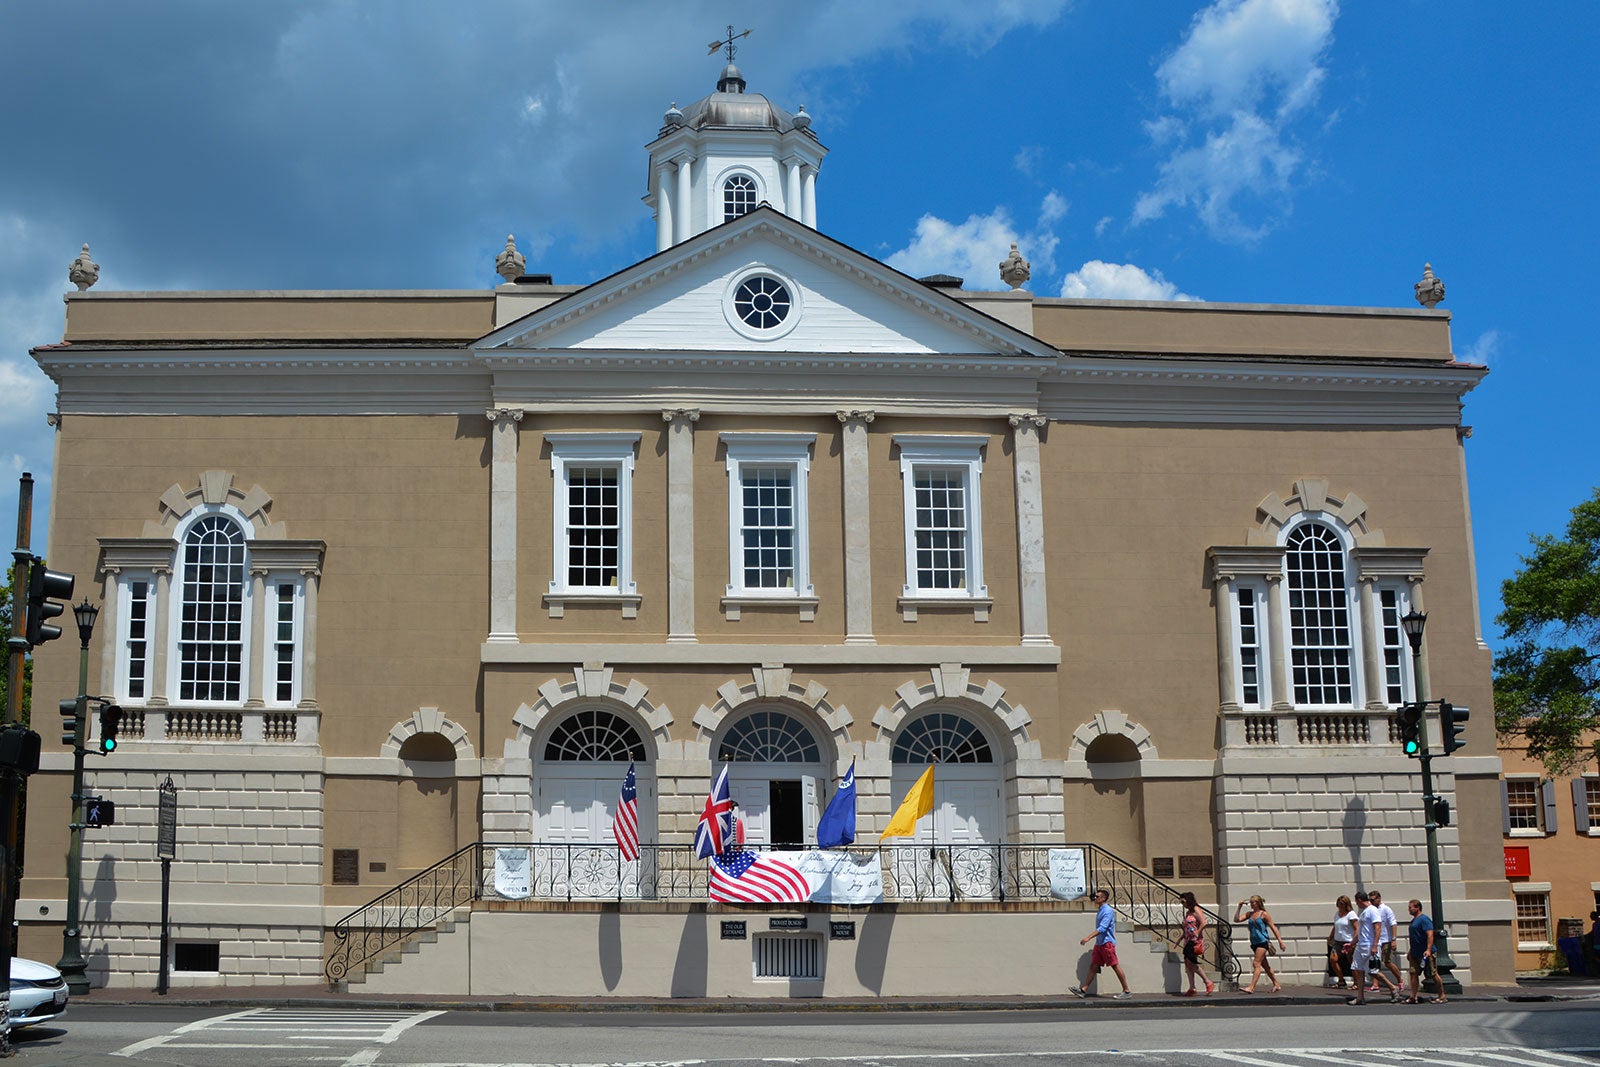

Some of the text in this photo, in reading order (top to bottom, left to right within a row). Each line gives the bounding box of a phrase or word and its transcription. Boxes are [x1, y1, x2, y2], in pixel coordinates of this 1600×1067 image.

[843, 867, 878, 878] Independence
[847, 879, 879, 892] July 4th
